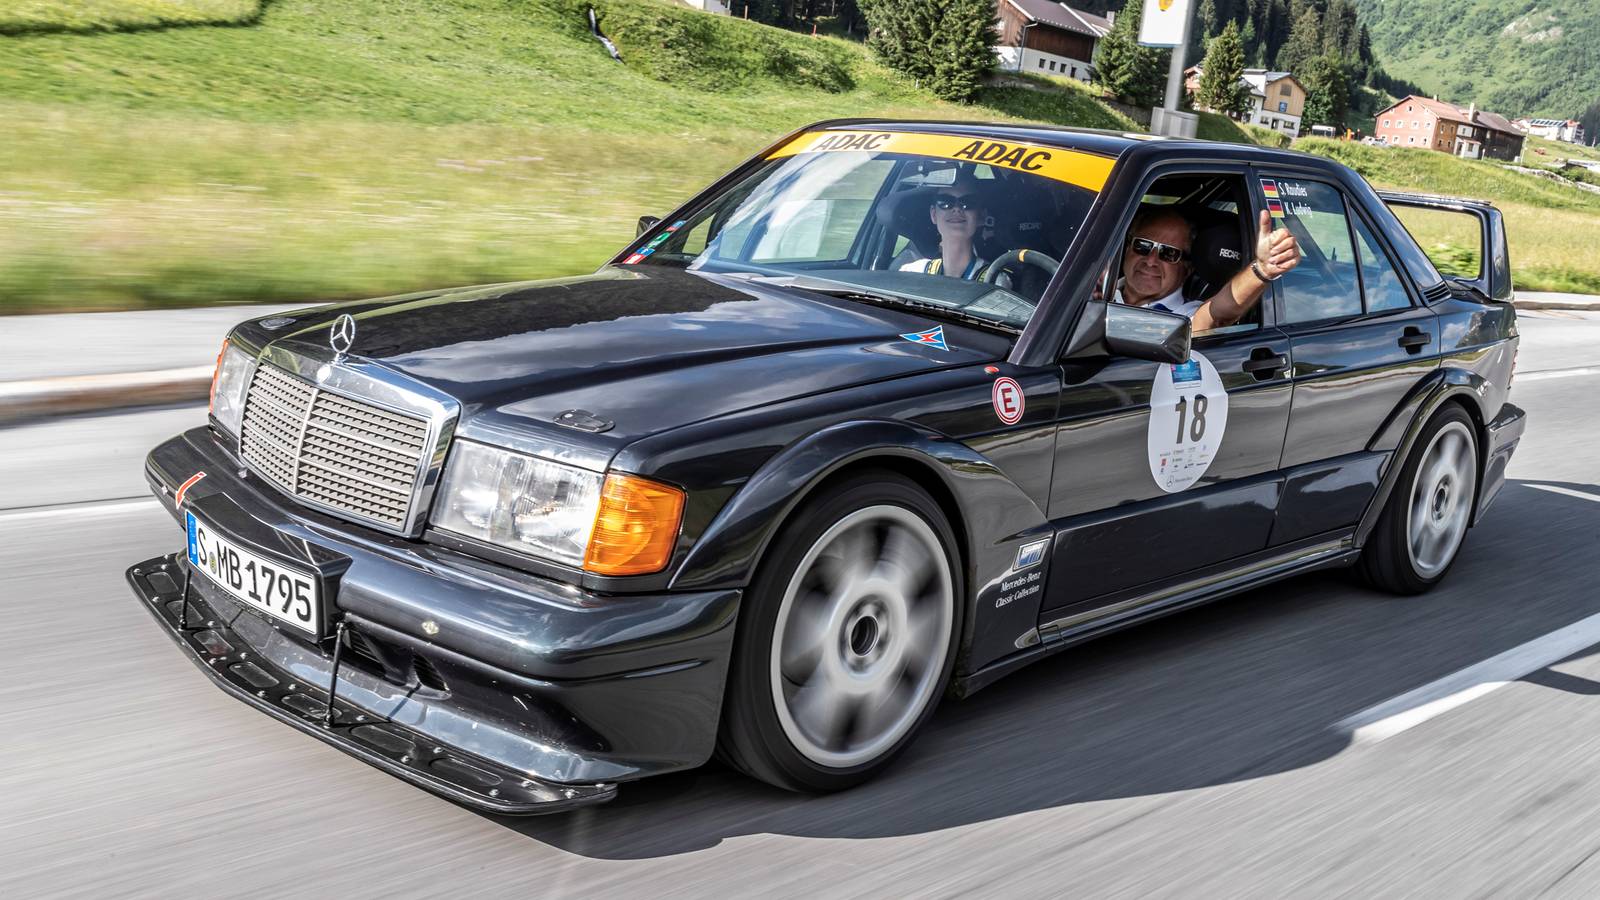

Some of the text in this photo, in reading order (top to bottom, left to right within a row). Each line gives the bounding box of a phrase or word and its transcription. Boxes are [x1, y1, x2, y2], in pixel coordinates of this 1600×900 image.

[815, 133, 1052, 171] ADAC ADAC
[1001, 387, 1016, 413] E
[1175, 393, 1209, 445] 18
[198, 527, 207, 567] S
[995, 585, 1040, 609] Classic Collection
